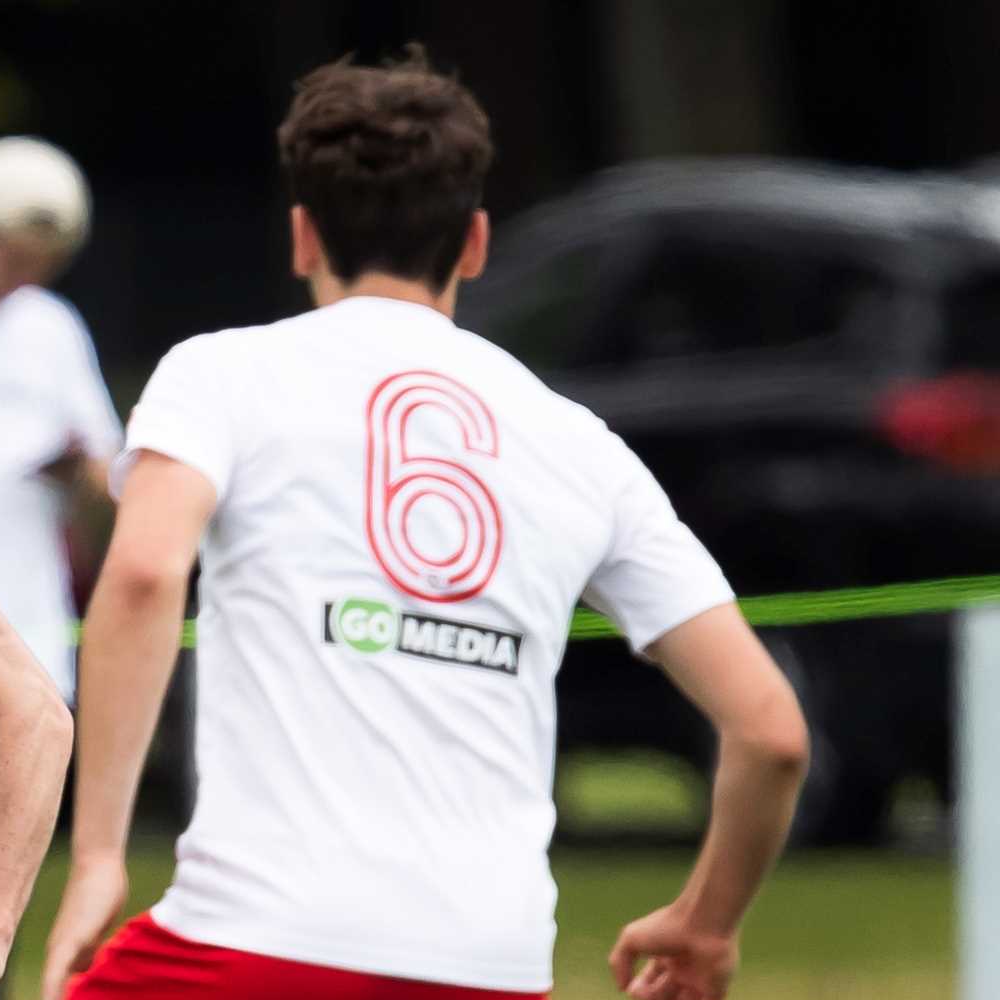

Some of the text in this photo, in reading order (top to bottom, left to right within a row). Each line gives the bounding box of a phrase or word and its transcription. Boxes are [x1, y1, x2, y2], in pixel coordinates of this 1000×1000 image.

[364, 369, 504, 603] 6
[342, 607, 519, 671] GO MEDIA
